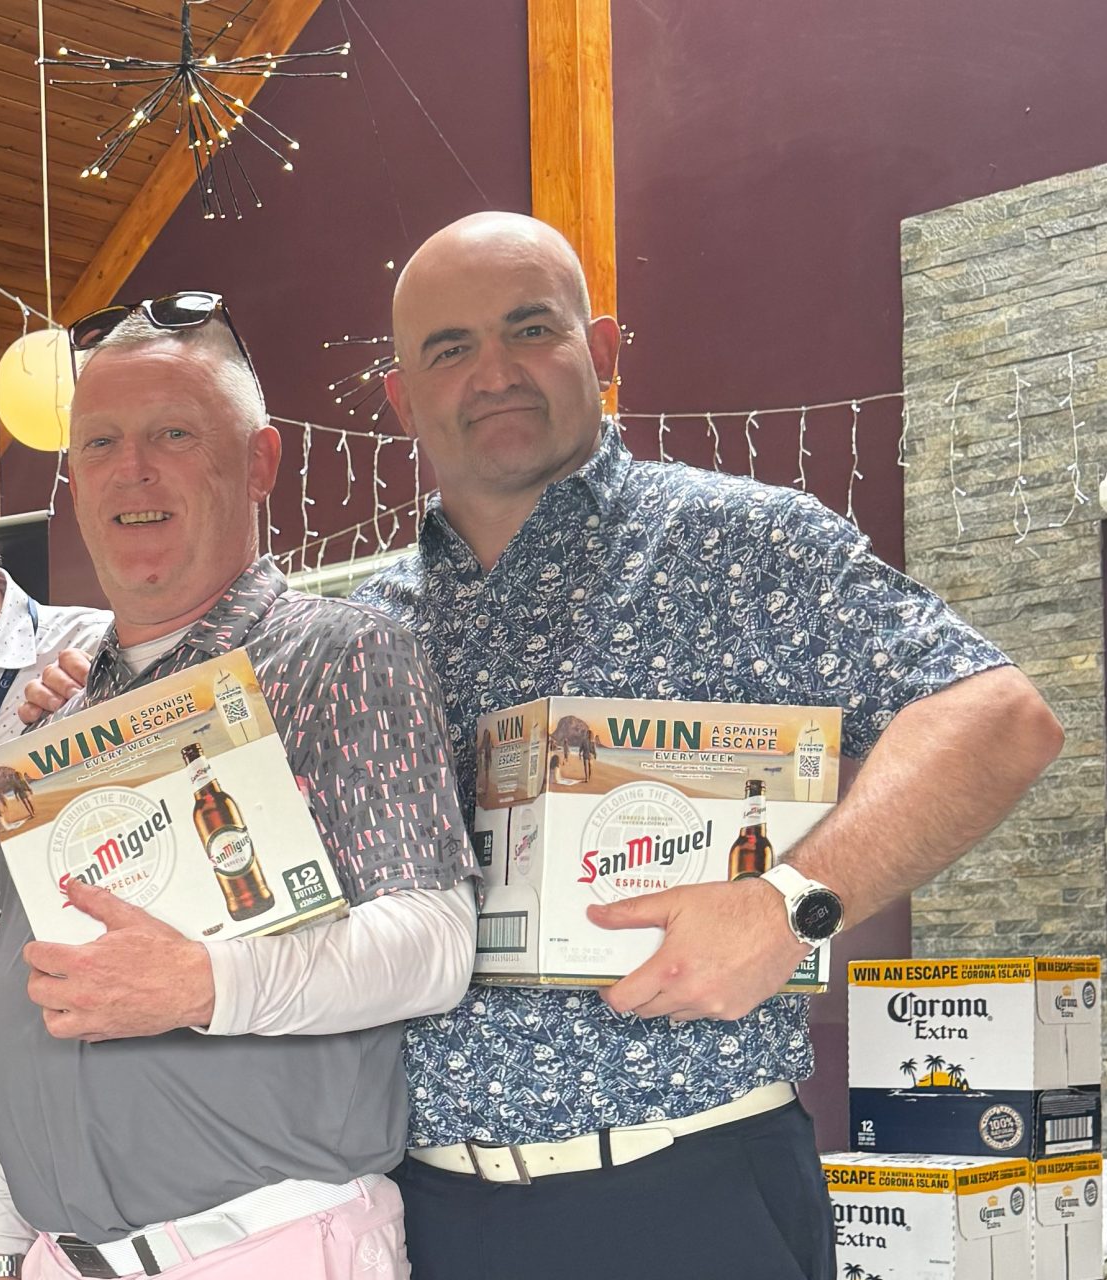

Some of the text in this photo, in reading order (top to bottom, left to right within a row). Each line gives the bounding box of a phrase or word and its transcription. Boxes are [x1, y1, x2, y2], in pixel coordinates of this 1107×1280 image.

[130, 693, 193, 723] A SPANISH
[131, 702, 197, 735] ESCAPE
[497, 715, 524, 742] WIN
[607, 717, 701, 750] WIN
[712, 726, 778, 737] A SPANISH
[28, 718, 125, 776] WIN
[85, 749, 122, 769] EVERY
[127, 734, 161, 752] WEEK
[711, 736, 777, 750] ESCAPE
[655, 752, 734, 762] EVERY WEEK
[592, 789, 700, 832] EXPLORING THE WORLD
[53, 801, 92, 853] EXPLORING
[93, 793, 114, 804] THE
[119, 793, 154, 817] WORLD
[104, 870, 150, 893] SPECIAL
[288, 866, 320, 891] 12
[615, 878, 669, 889] ESPECIAL
[853, 965, 958, 981] WIN AN ESCAPE
[961, 969, 1031, 979] CORONA ISLAND
[887, 991, 989, 1026] Corona
[915, 1019, 968, 1040] Extra
[860, 1120, 874, 1132] 12
[988, 1117, 1014, 1130] 100%
[879, 1177, 949, 1189] CORONA ISLAND
[833, 1203, 907, 1227] orona
[835, 1225, 887, 1249] Extra
